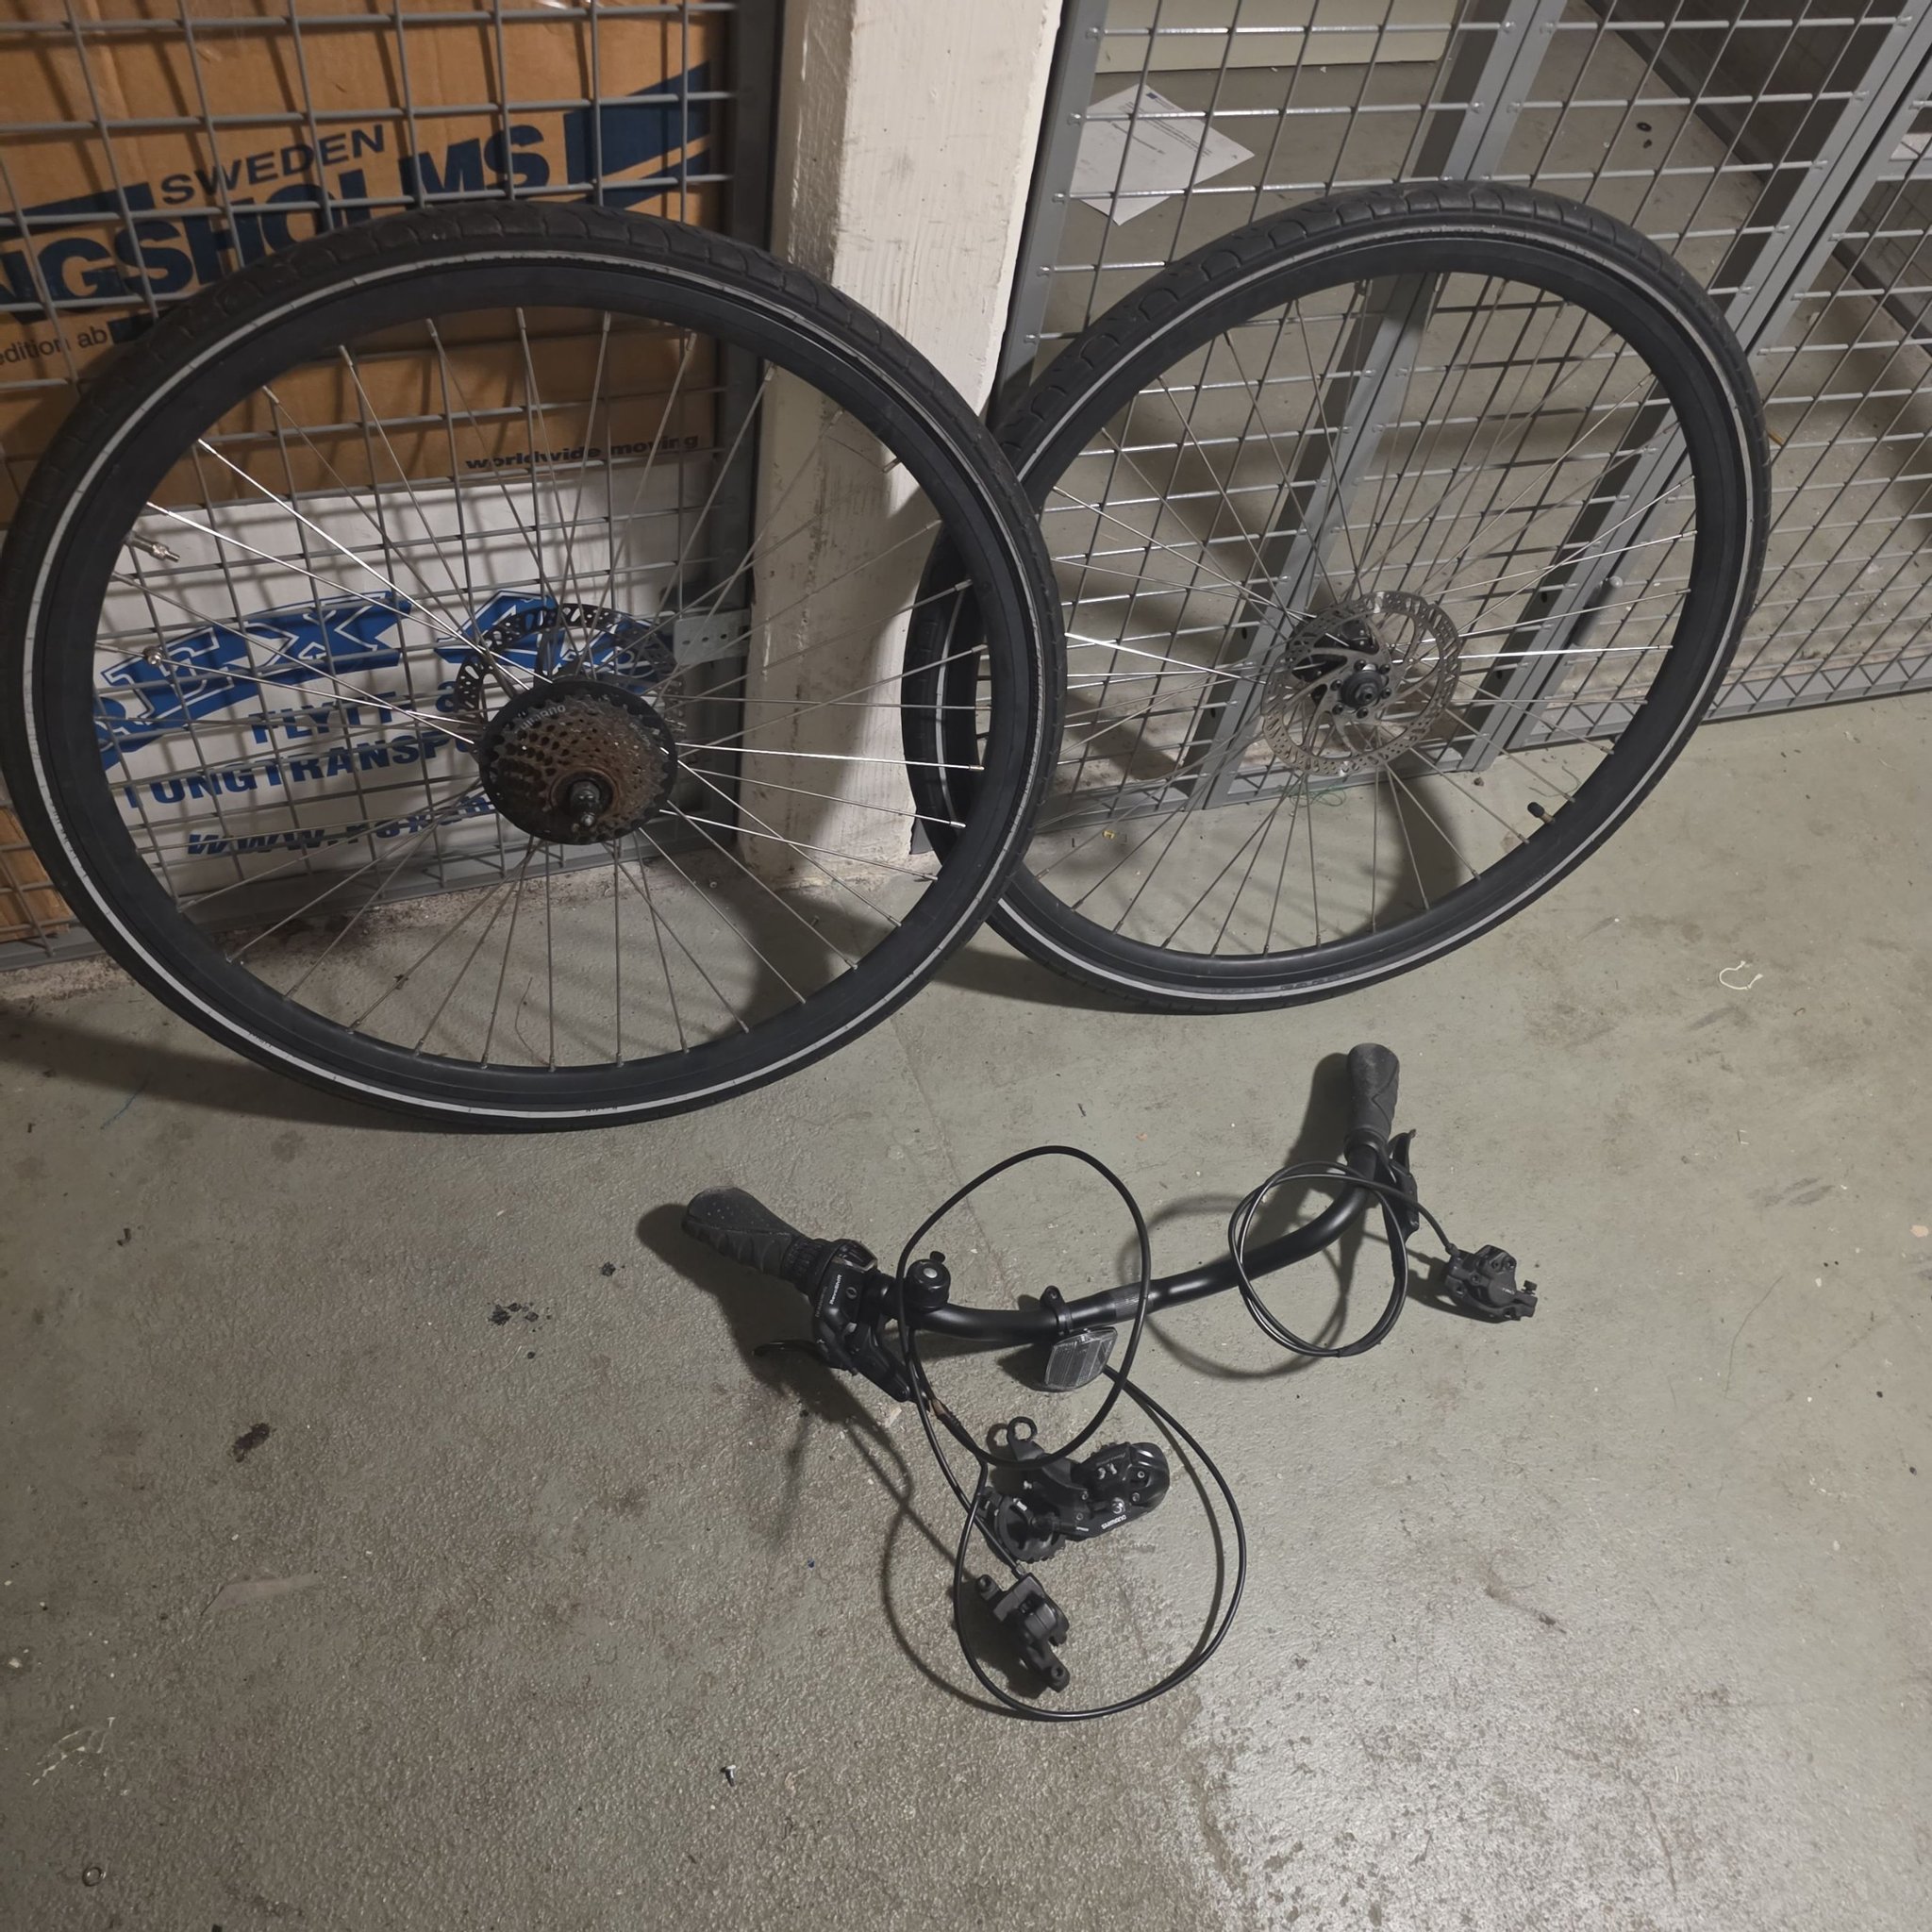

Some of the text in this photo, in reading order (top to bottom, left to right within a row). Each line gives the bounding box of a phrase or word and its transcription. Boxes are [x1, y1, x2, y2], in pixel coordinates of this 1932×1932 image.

[161, 125, 384, 204] SWEDEN
[77, 326, 108, 348] ab
[466, 435, 699, 468] worldwide moving
[249, 691, 396, 744] FLYTT
